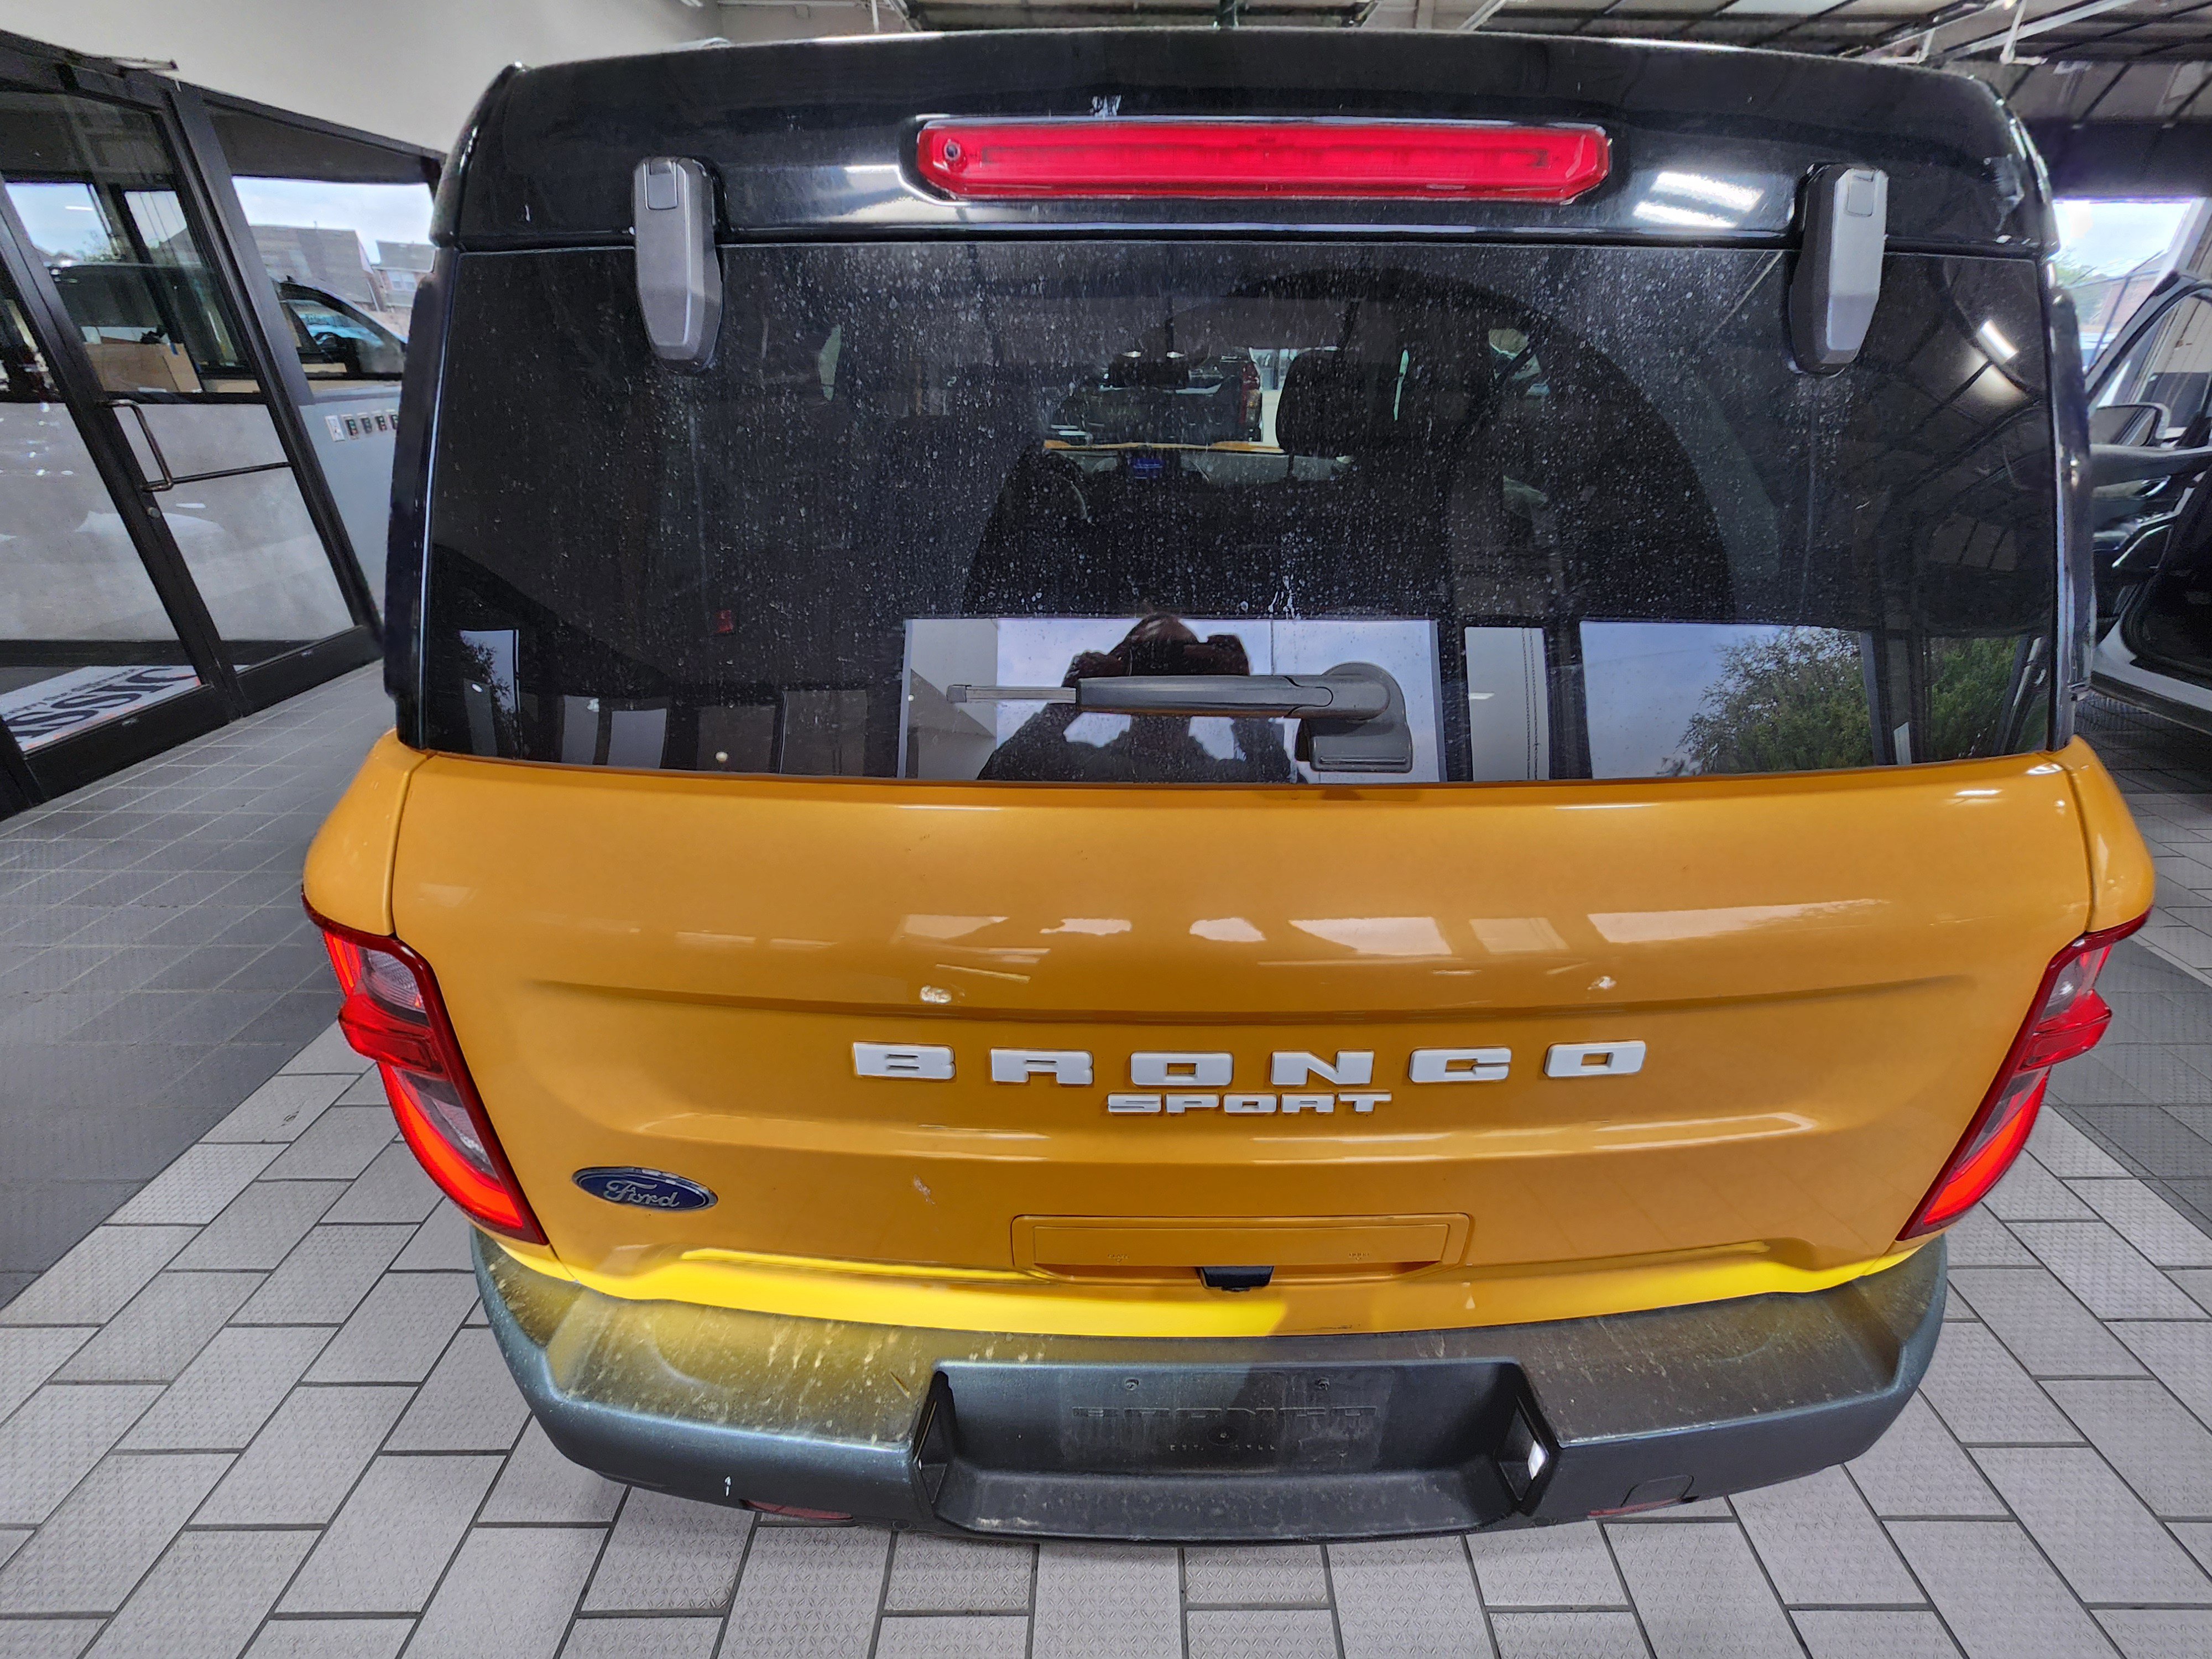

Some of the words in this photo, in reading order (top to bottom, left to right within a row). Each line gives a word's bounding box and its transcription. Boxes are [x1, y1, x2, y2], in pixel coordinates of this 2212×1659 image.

[853, 1040, 1646, 1086] BRONCO
[1108, 1092, 1392, 1113] SPORT
[602, 1180, 681, 1209] Ford
